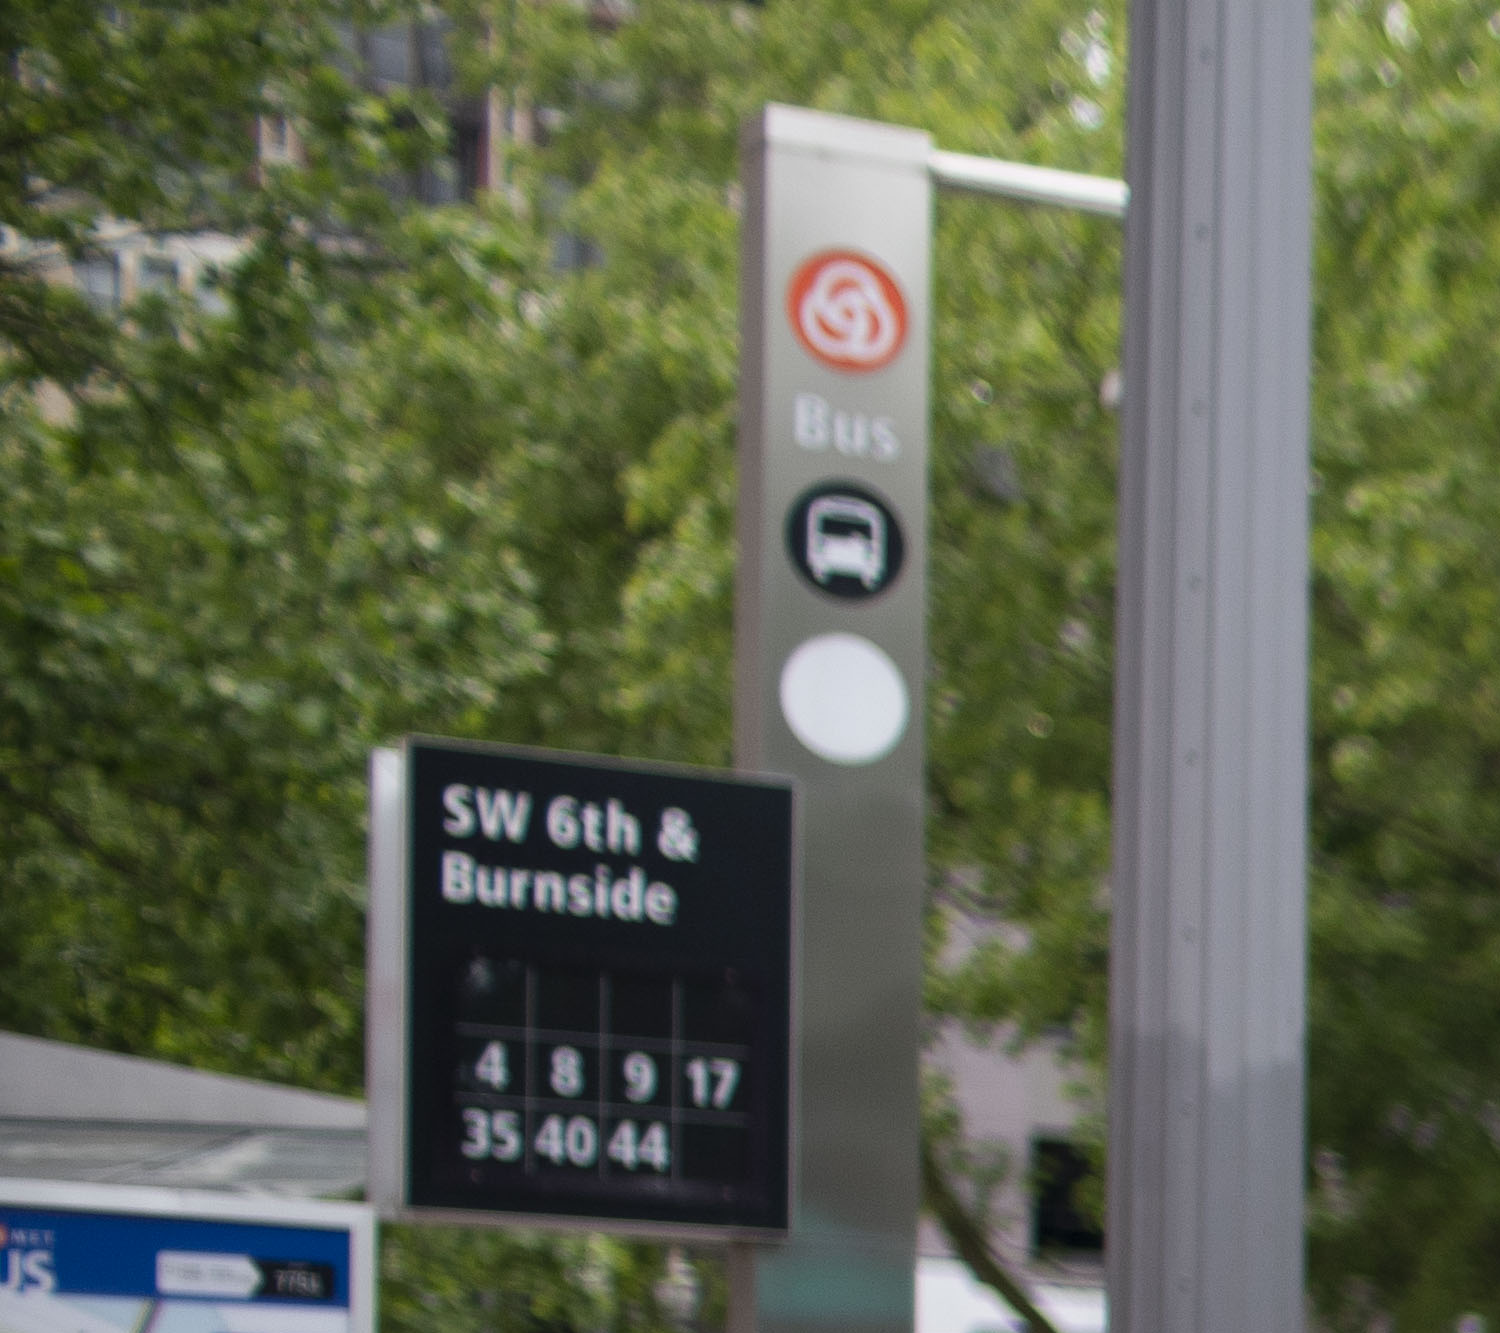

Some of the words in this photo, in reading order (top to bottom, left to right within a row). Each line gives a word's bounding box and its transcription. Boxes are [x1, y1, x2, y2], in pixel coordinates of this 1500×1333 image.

[794, 393, 899, 463] Bus
[442, 783, 532, 844] SW
[547, 795, 642, 857] 6th
[657, 807, 699, 863] &
[441, 850, 679, 926] Burnside
[474, 1040, 509, 1092] 4
[550, 1046, 584, 1098] 8
[622, 1051, 658, 1104] 9
[685, 1056, 741, 1110] 17
[460, 1106, 523, 1162] 35
[534, 1113, 598, 1168] 40
[607, 1118, 671, 1173] 44
